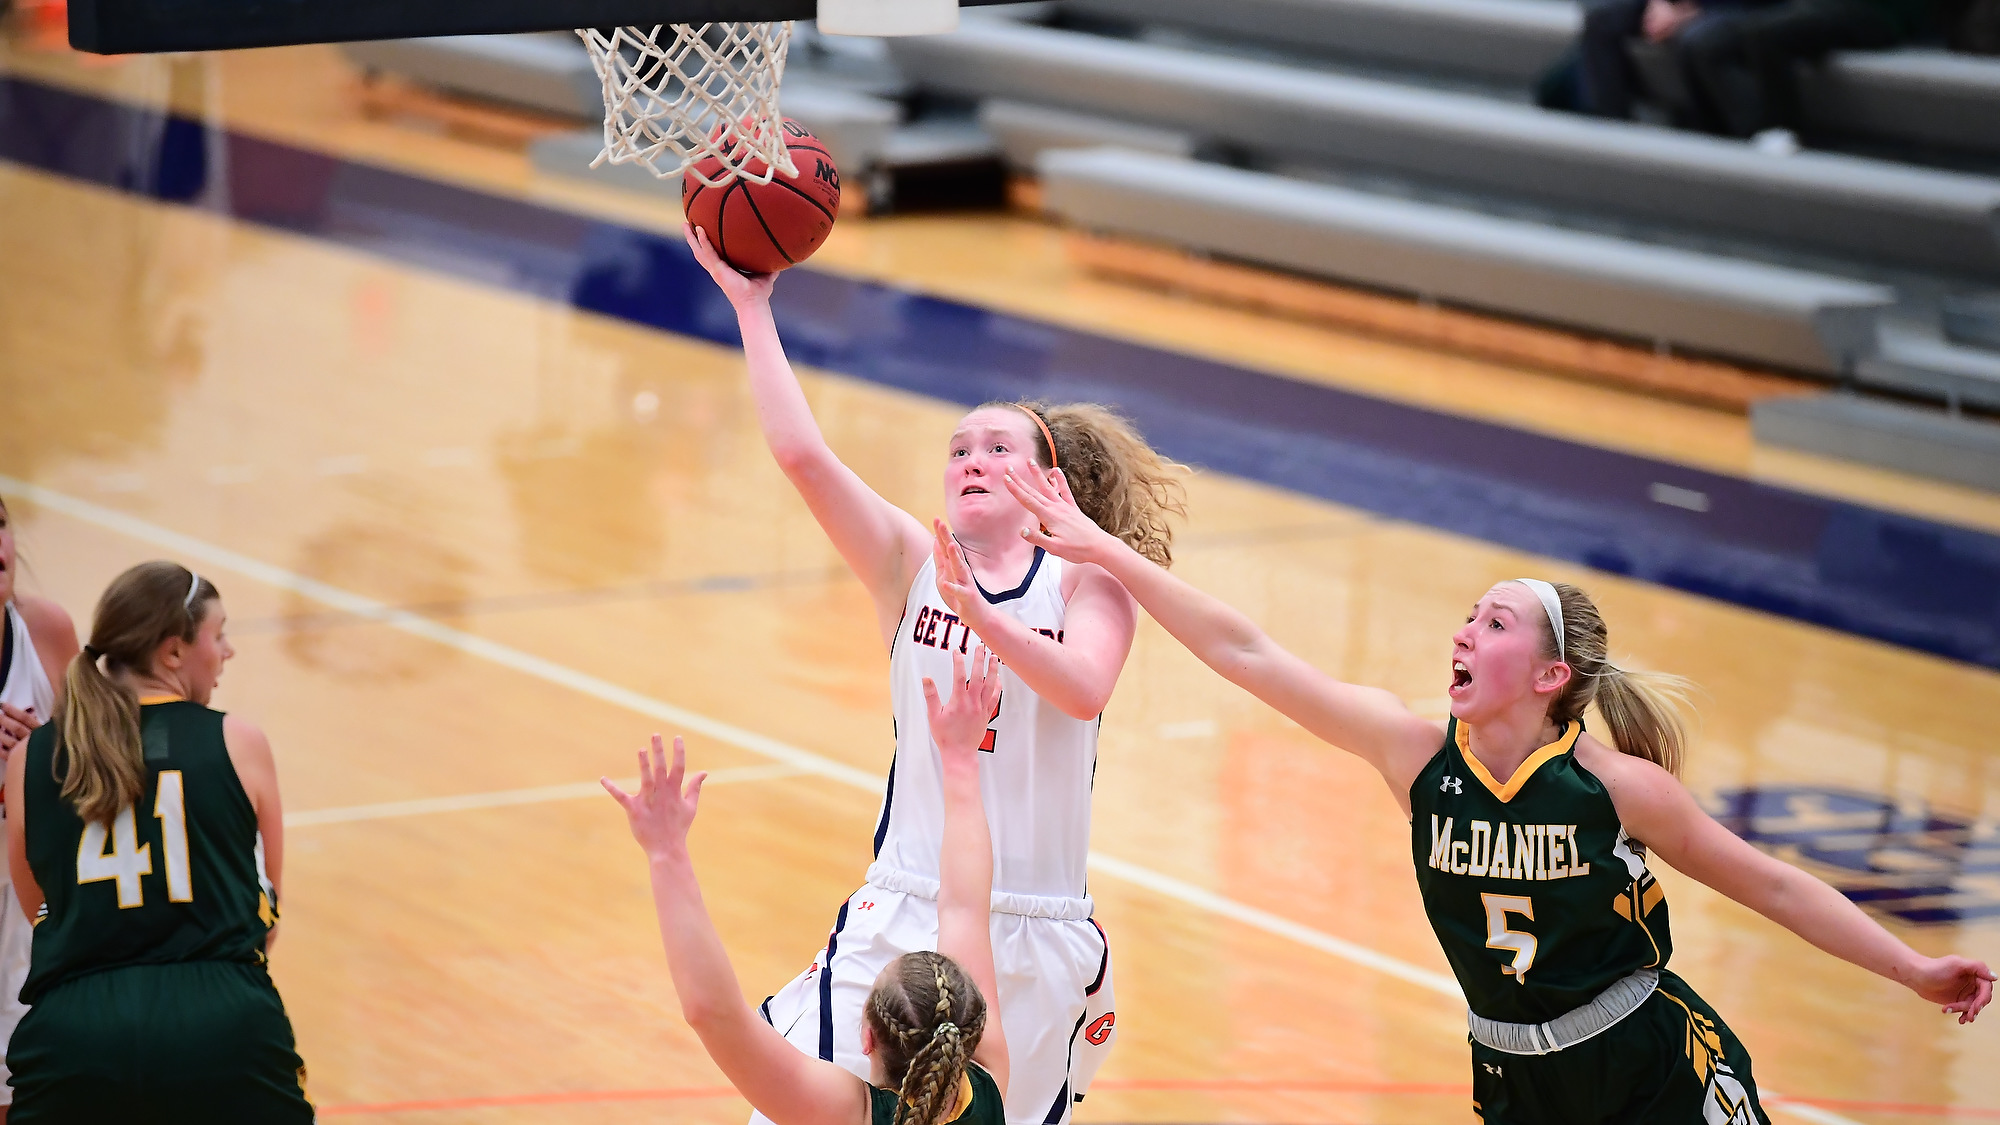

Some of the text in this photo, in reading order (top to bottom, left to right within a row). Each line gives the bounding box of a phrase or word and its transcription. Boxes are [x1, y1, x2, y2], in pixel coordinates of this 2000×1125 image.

[77, 770, 193, 909] 41
[1480, 892, 1538, 985] 5
[1085, 1011, 1115, 1046] G
